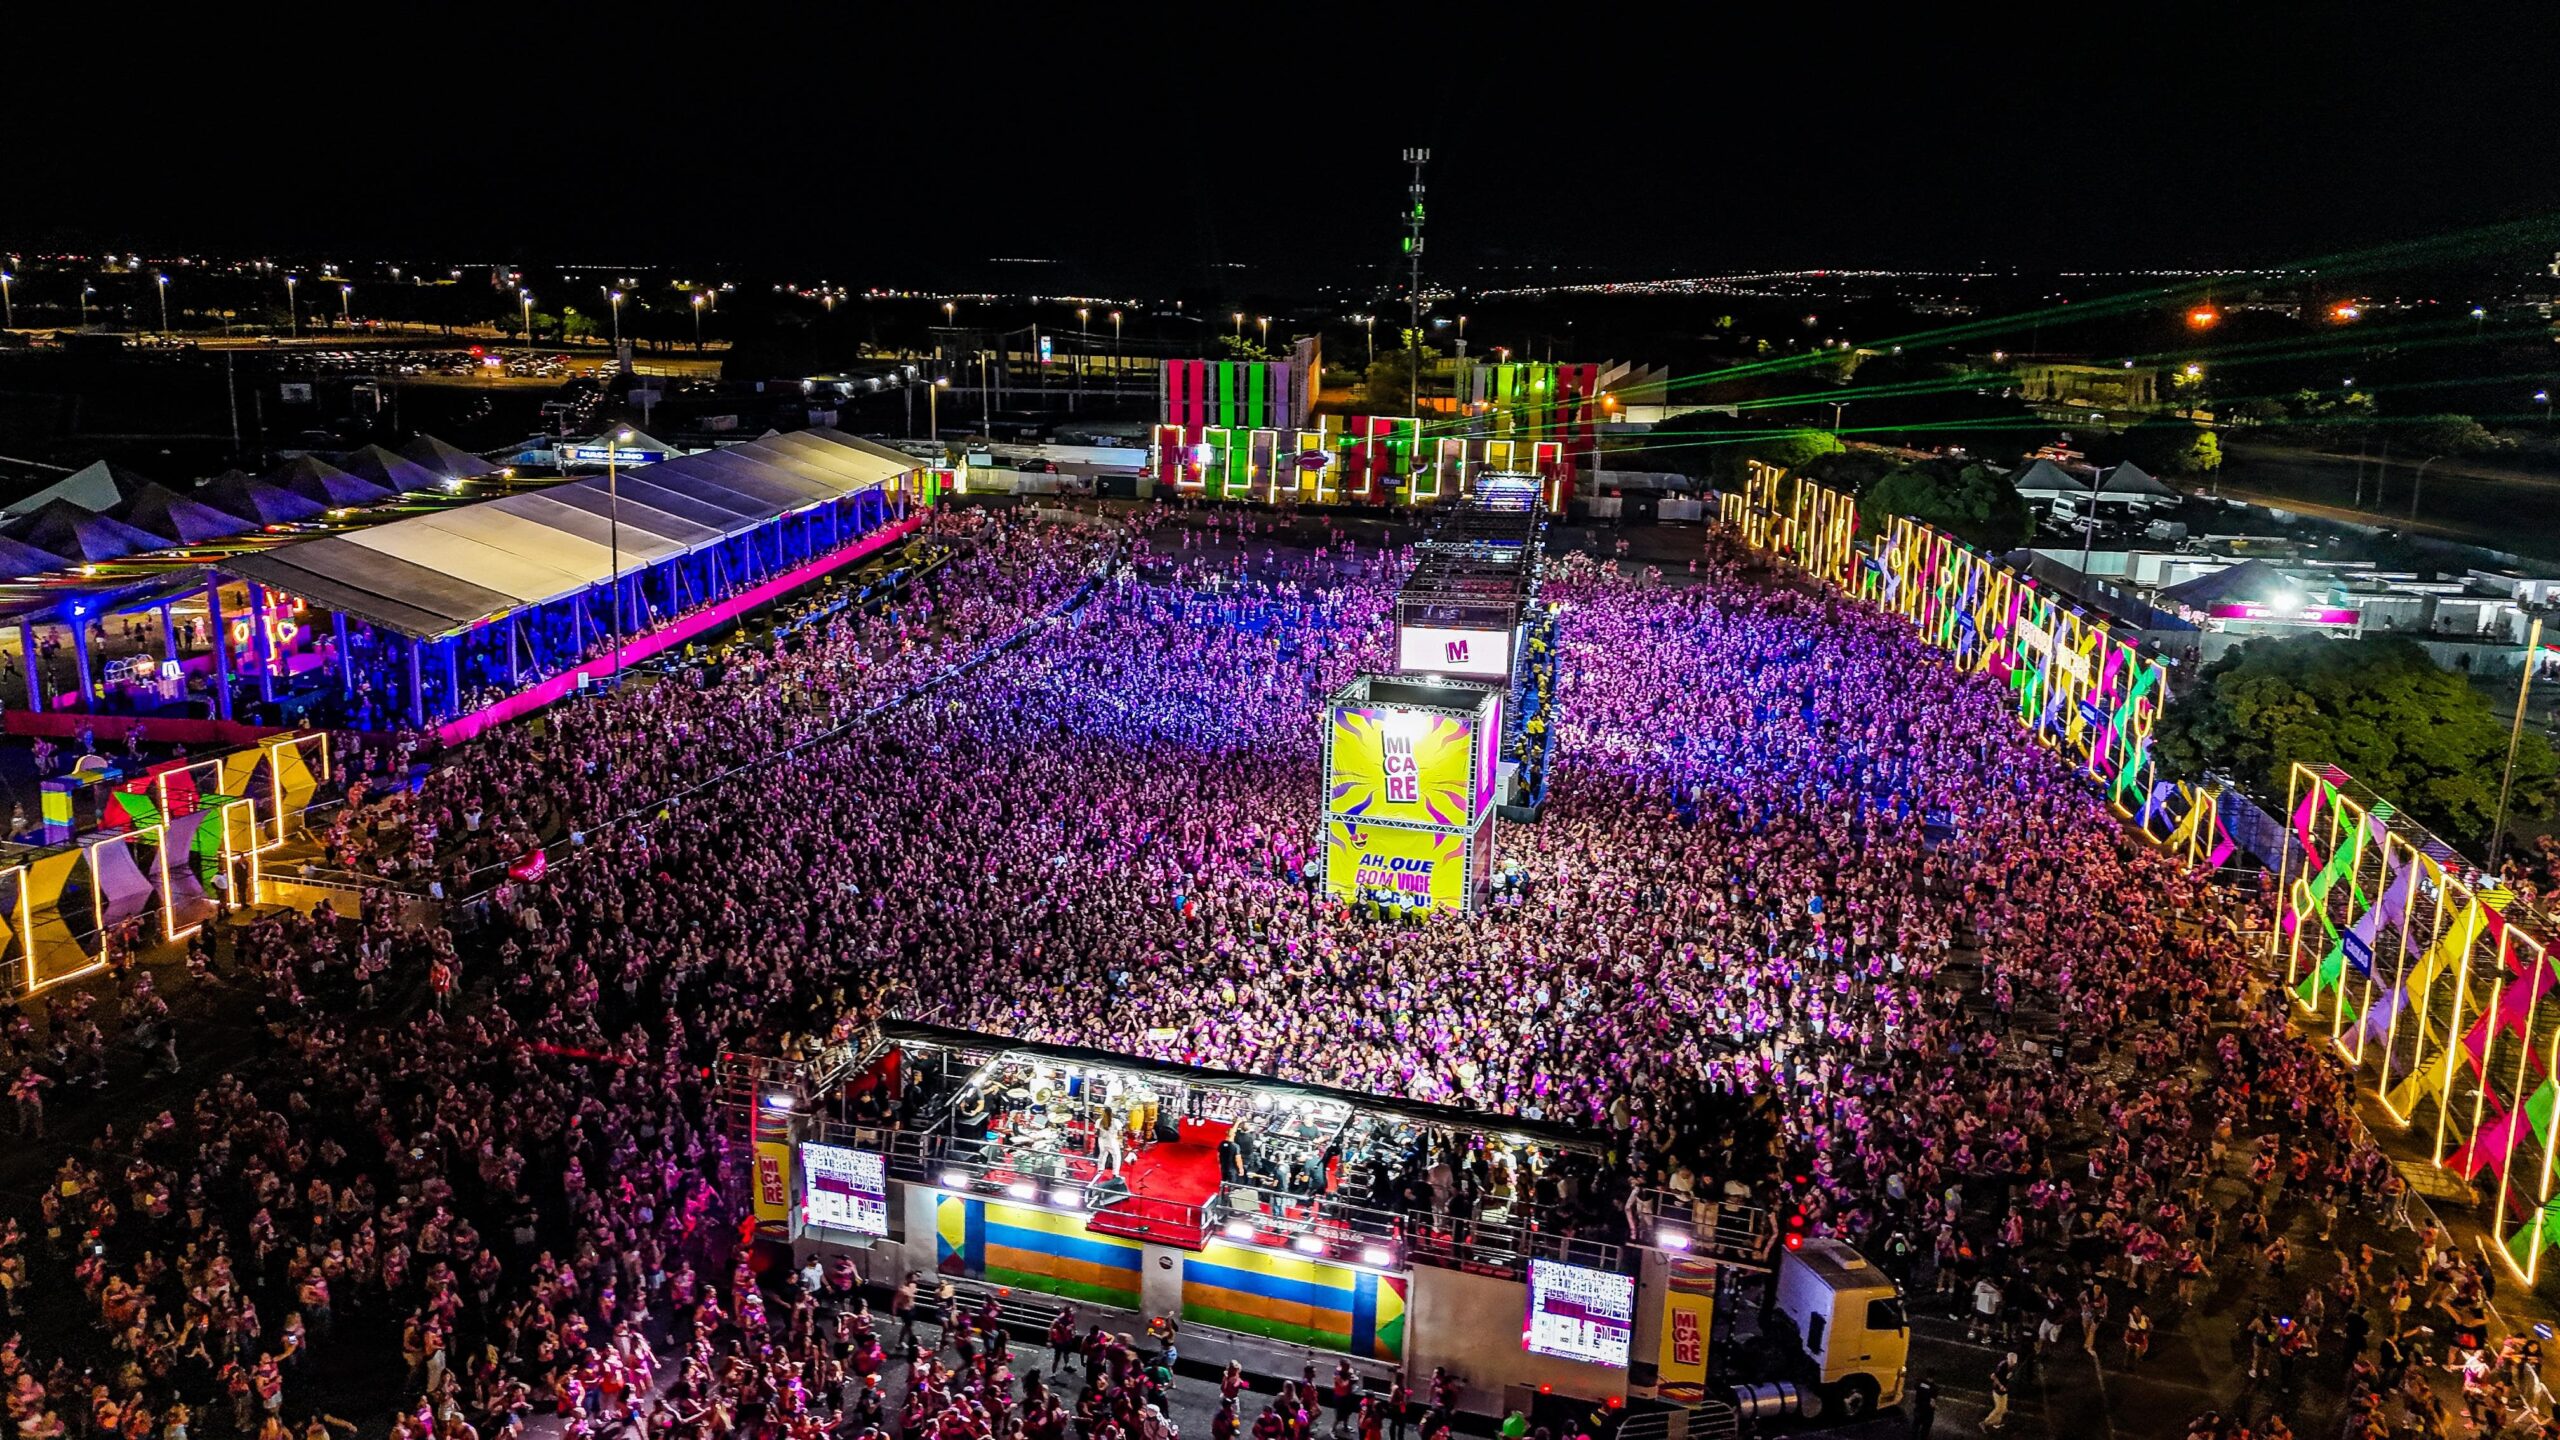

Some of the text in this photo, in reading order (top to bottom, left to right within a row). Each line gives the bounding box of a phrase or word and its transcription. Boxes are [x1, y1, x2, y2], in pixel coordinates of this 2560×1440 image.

[579, 450, 644, 460] MASCLINO
[1387, 736, 1411, 754] MI
[1388, 756, 1416, 773] CA
[1390, 772, 1417, 799] RÊ
[1389, 857, 1434, 873] QUE
[1356, 868, 1394, 887] BOM
[763, 1160, 778, 1172] MI
[764, 1173, 782, 1184] CA
[1677, 1313, 1697, 1328] MI
[1677, 1328, 1701, 1341] CA
[1678, 1341, 1701, 1362] RÊ
